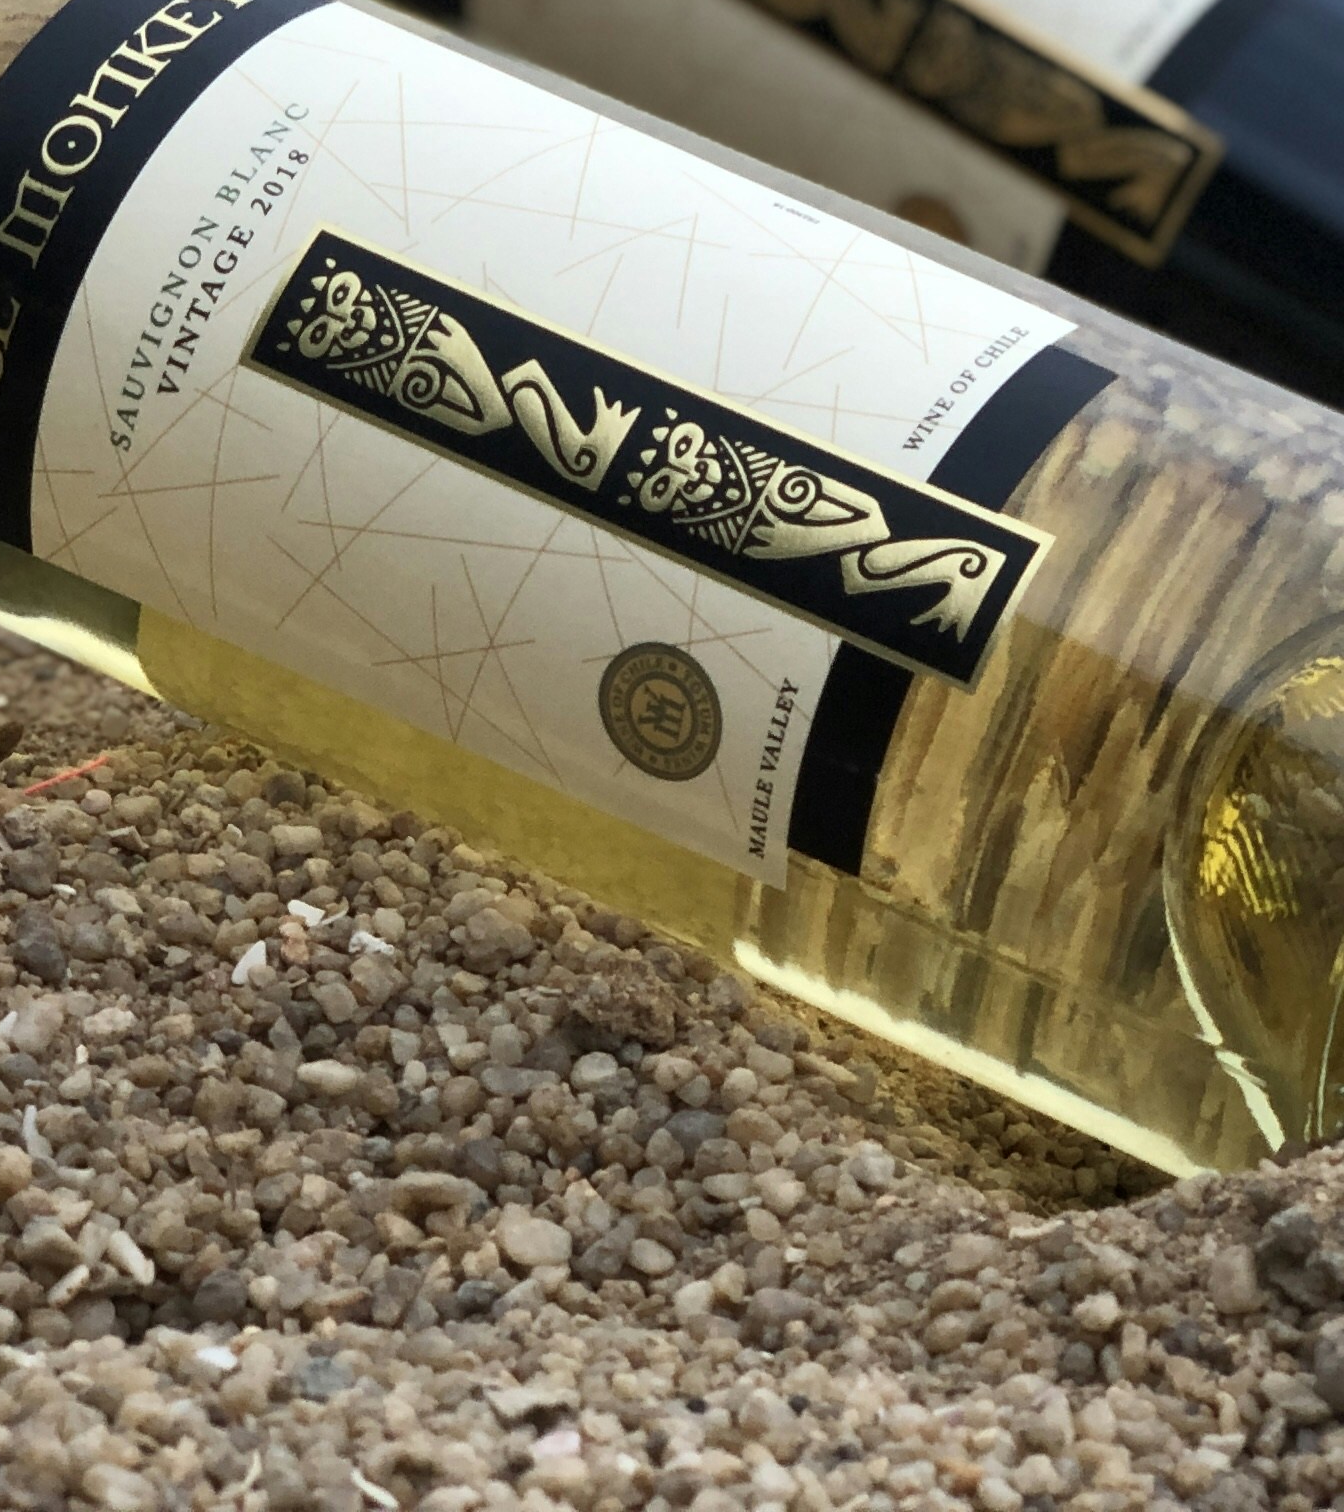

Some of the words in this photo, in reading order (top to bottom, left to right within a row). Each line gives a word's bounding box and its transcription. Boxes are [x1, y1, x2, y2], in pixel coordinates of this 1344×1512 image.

[110, 215, 220, 452] SAUVIGNON
[215, 102, 310, 207] BLANC
[156, 225, 255, 394] VINTAGE
[250, 148, 310, 217] 2018
[902, 396, 955, 450] WINE
[949, 369, 977, 394] OF
[974, 326, 1030, 368] CHILE
[759, 677, 800, 771] VALLEY
[748, 778, 774, 859] MAULE
